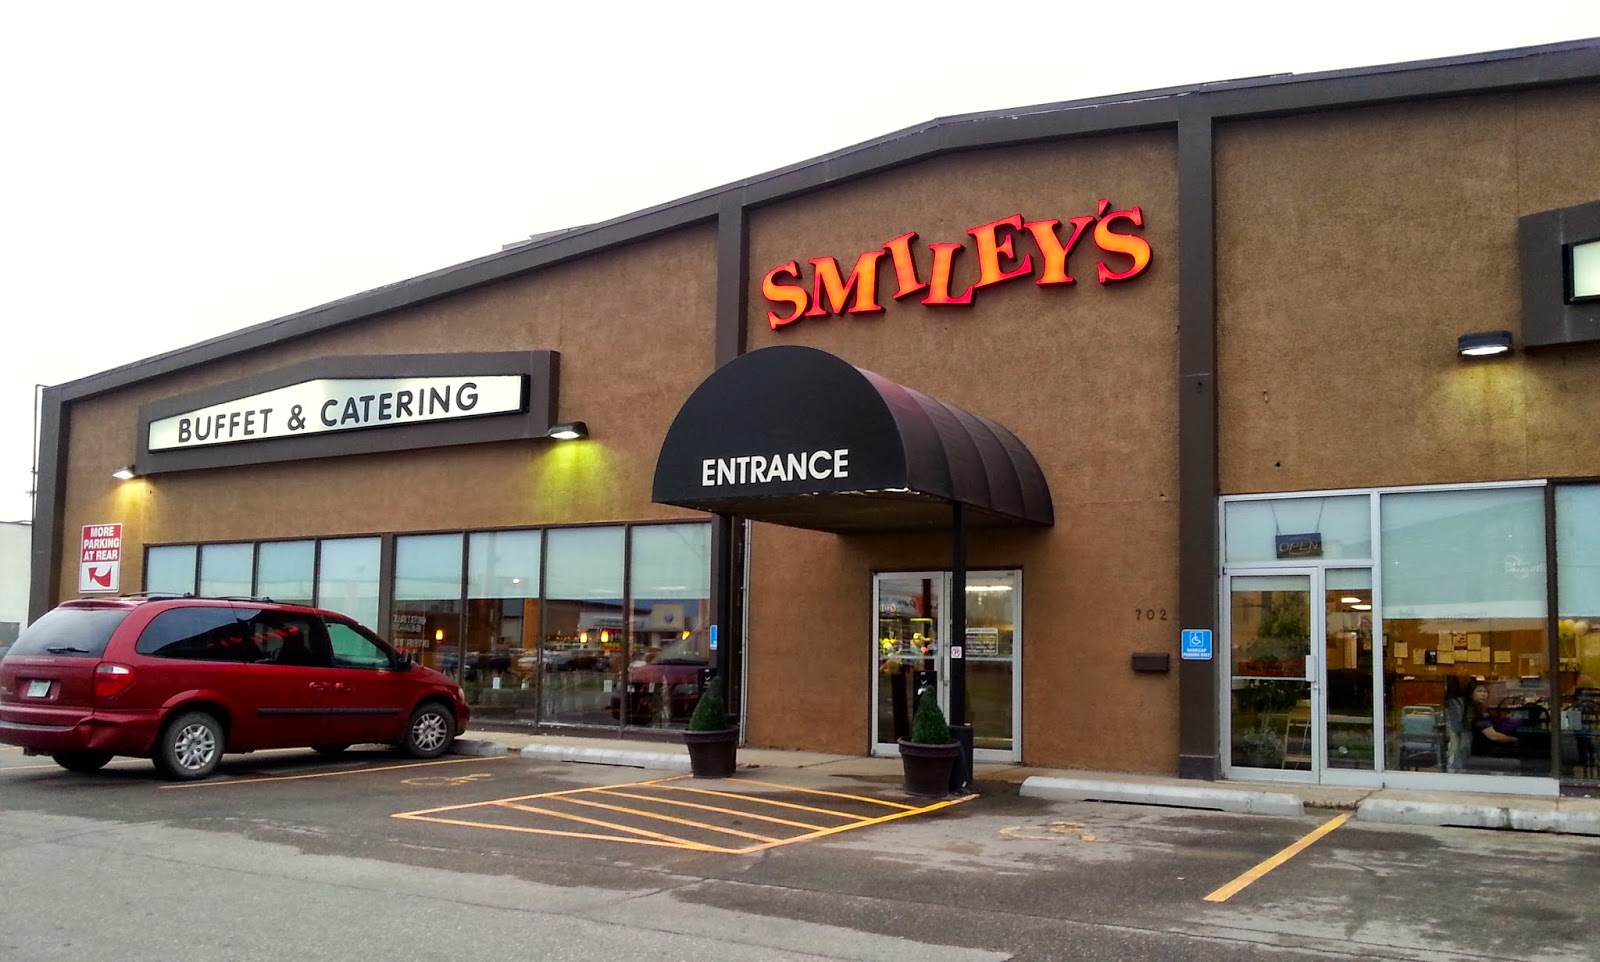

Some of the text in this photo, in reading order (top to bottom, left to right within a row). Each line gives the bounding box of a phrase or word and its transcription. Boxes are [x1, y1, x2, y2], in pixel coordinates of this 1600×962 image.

[761, 198, 1152, 331] SMILEY'S
[178, 382, 479, 443] BUFFET & CATERING
[702, 449, 849, 486] ENTRANCE
[90, 526, 115, 538] MORE
[83, 538, 120, 549] PARKING
[1279, 540, 1318, 552] OPEN
[83, 549, 118, 561] AT REAR
[1135, 609, 1167, 621] 702
